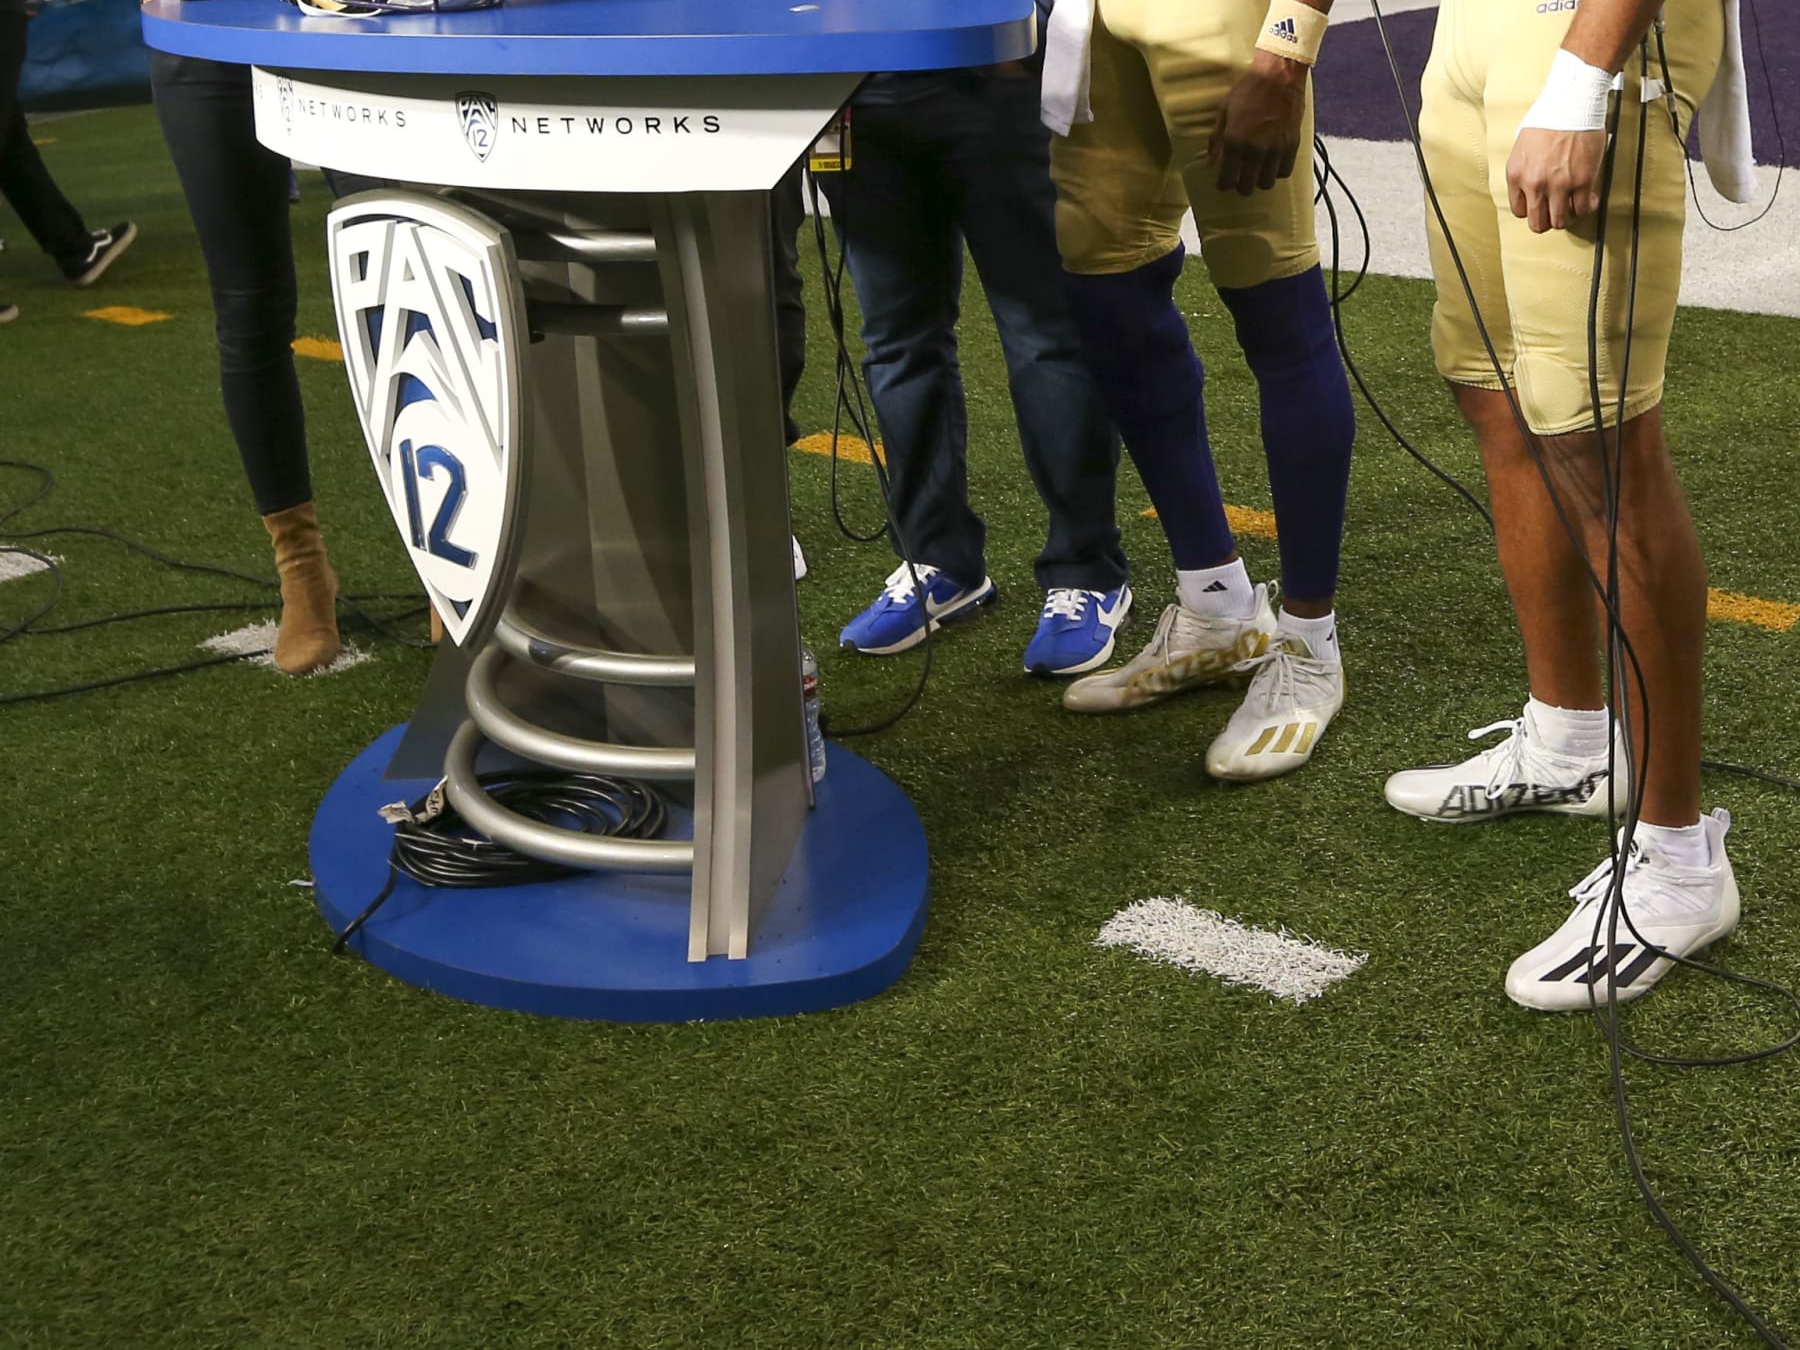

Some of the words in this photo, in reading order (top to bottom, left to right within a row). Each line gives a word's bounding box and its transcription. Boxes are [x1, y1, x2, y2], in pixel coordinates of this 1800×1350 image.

[1268, 26, 1298, 44] adidas
[298, 98, 407, 128] NETWORKS
[511, 115, 721, 135] NETWORKS
[472, 129, 489, 148] 12
[333, 218, 507, 435] PAC
[399, 438, 479, 571] 12
